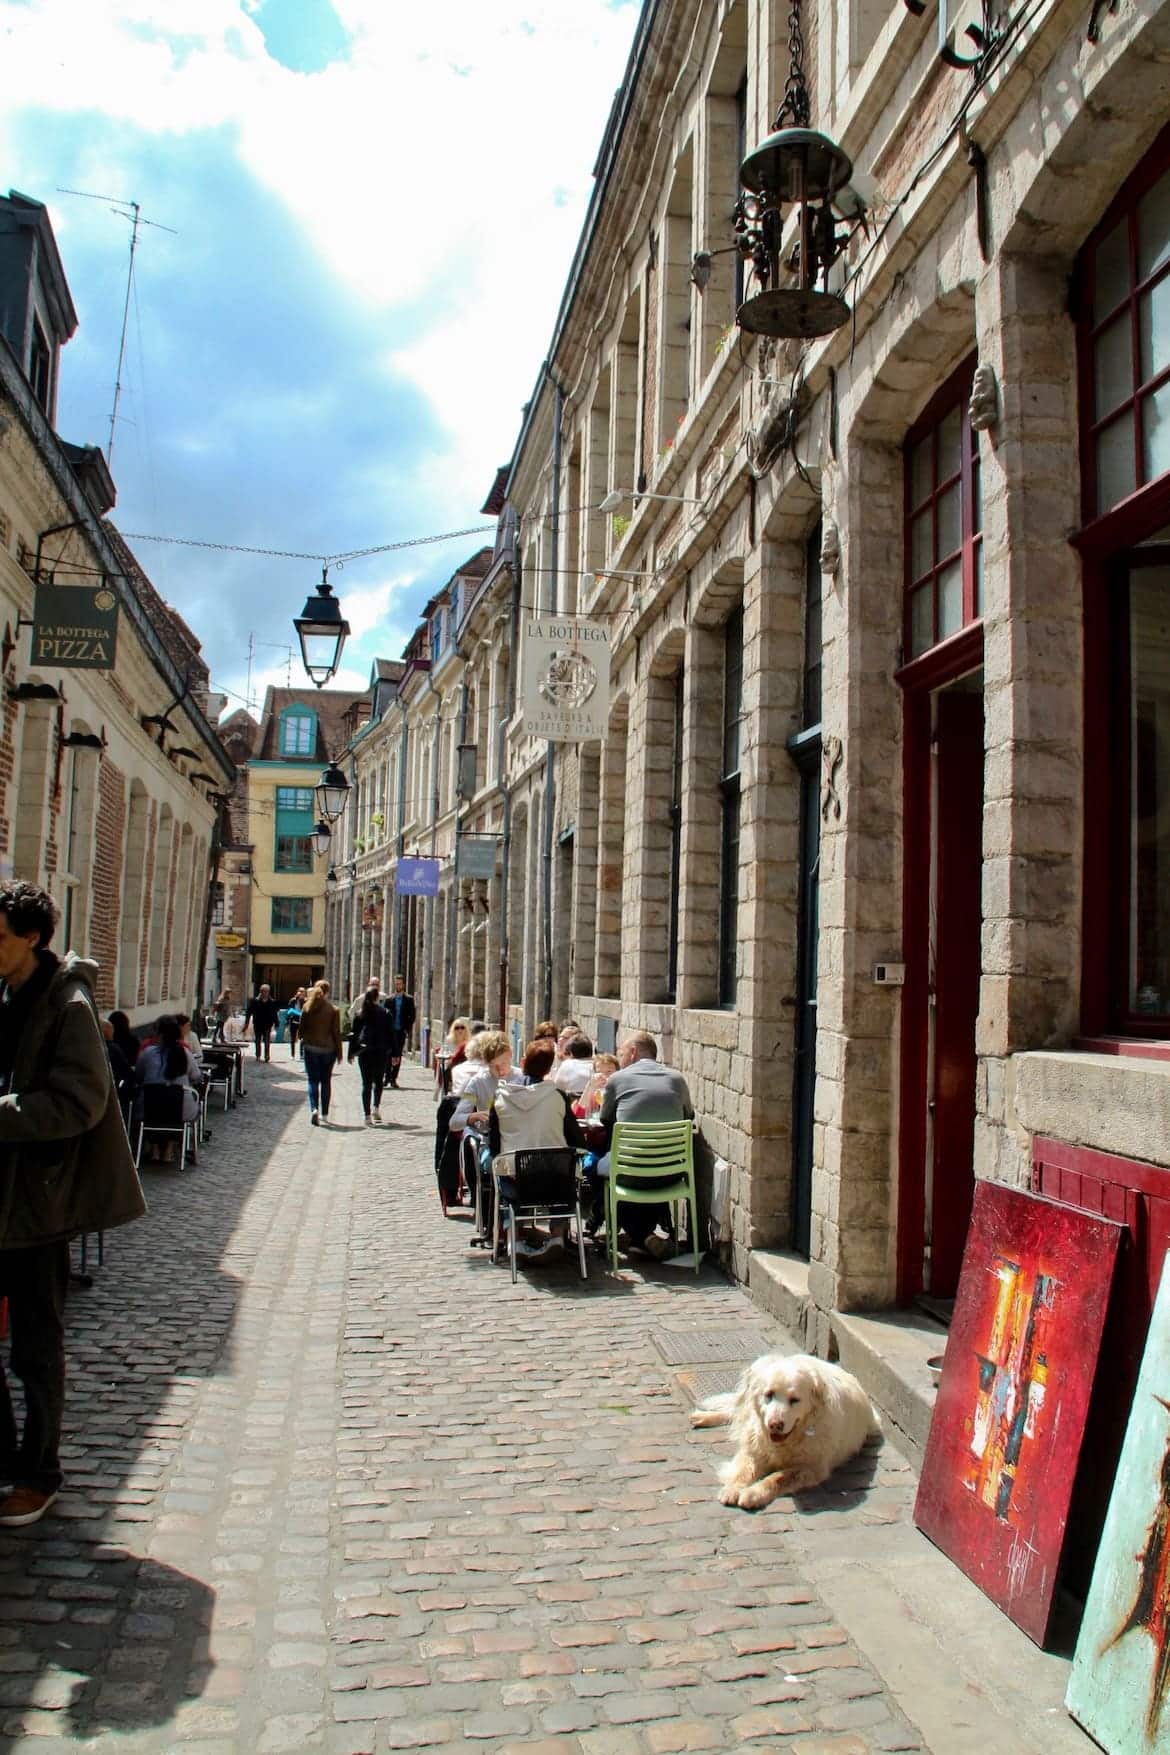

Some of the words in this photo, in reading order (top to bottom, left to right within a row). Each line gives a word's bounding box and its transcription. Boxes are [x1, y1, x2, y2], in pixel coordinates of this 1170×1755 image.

[39, 625, 53, 636] LA
[56, 626, 110, 639] BOTTEGA
[528, 623, 543, 638] LA
[549, 625, 608, 642] BOTTEGA
[39, 639, 109, 661] PIZZA
